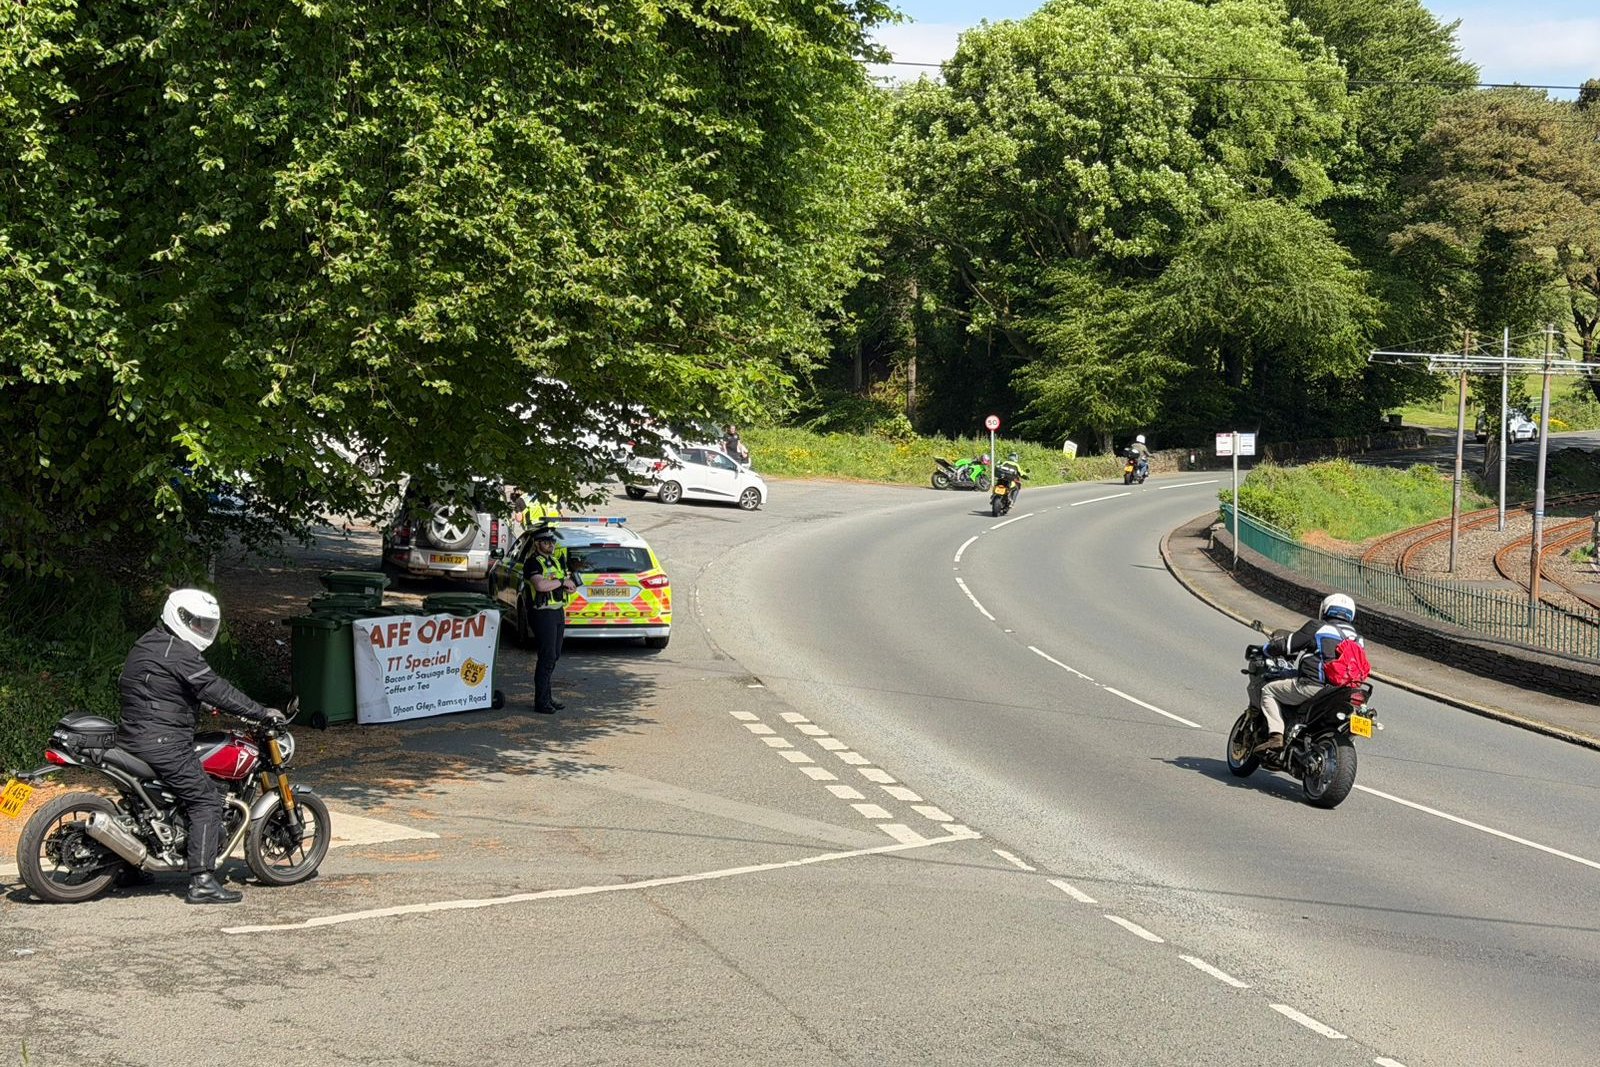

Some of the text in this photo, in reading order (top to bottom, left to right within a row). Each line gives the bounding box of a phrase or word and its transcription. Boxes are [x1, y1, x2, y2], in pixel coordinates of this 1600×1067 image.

[565, 611, 653, 619] POLICE
[417, 615, 486, 644] OPEN
[387, 656, 403, 672] TT
[466, 662, 483, 673] ONLY
[385, 675, 406, 684] Bacon
[446, 666, 460, 675] Bap
[463, 669, 478, 683] £5
[417, 681, 430, 690] Tea
[437, 697, 467, 707] Ramsey
[468, 693, 487, 704] Road
